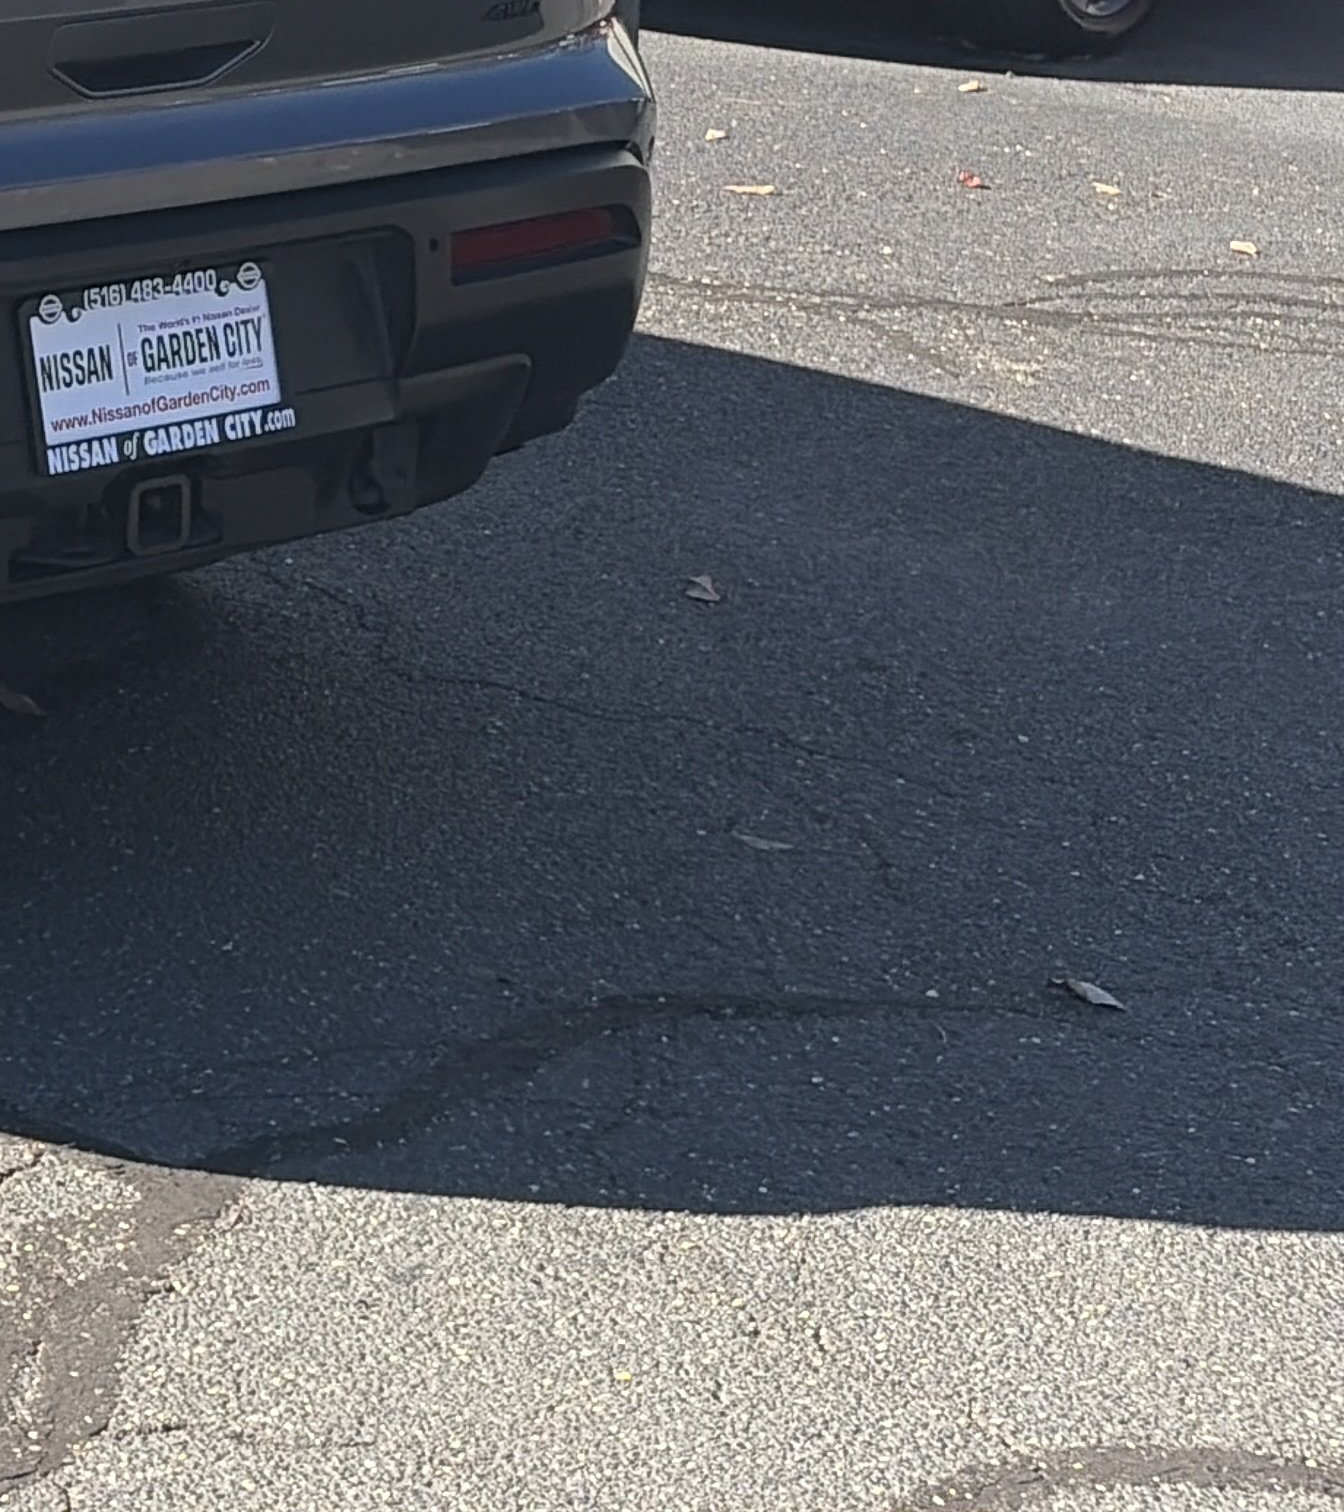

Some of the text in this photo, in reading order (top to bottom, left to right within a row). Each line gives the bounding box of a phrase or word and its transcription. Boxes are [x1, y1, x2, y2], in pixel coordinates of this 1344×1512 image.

[83, 269, 217, 311] (516) 483-4400
[202, 308, 233, 322] Nissan
[39, 316, 263, 393] NISSAN OF GARDEN CITY
[143, 369, 189, 386] Because
[50, 378, 271, 433] www.NissanofGardenCity.com
[46, 436, 119, 476] NISSAN
[123, 431, 139, 461] of
[143, 419, 221, 457] GARDEN
